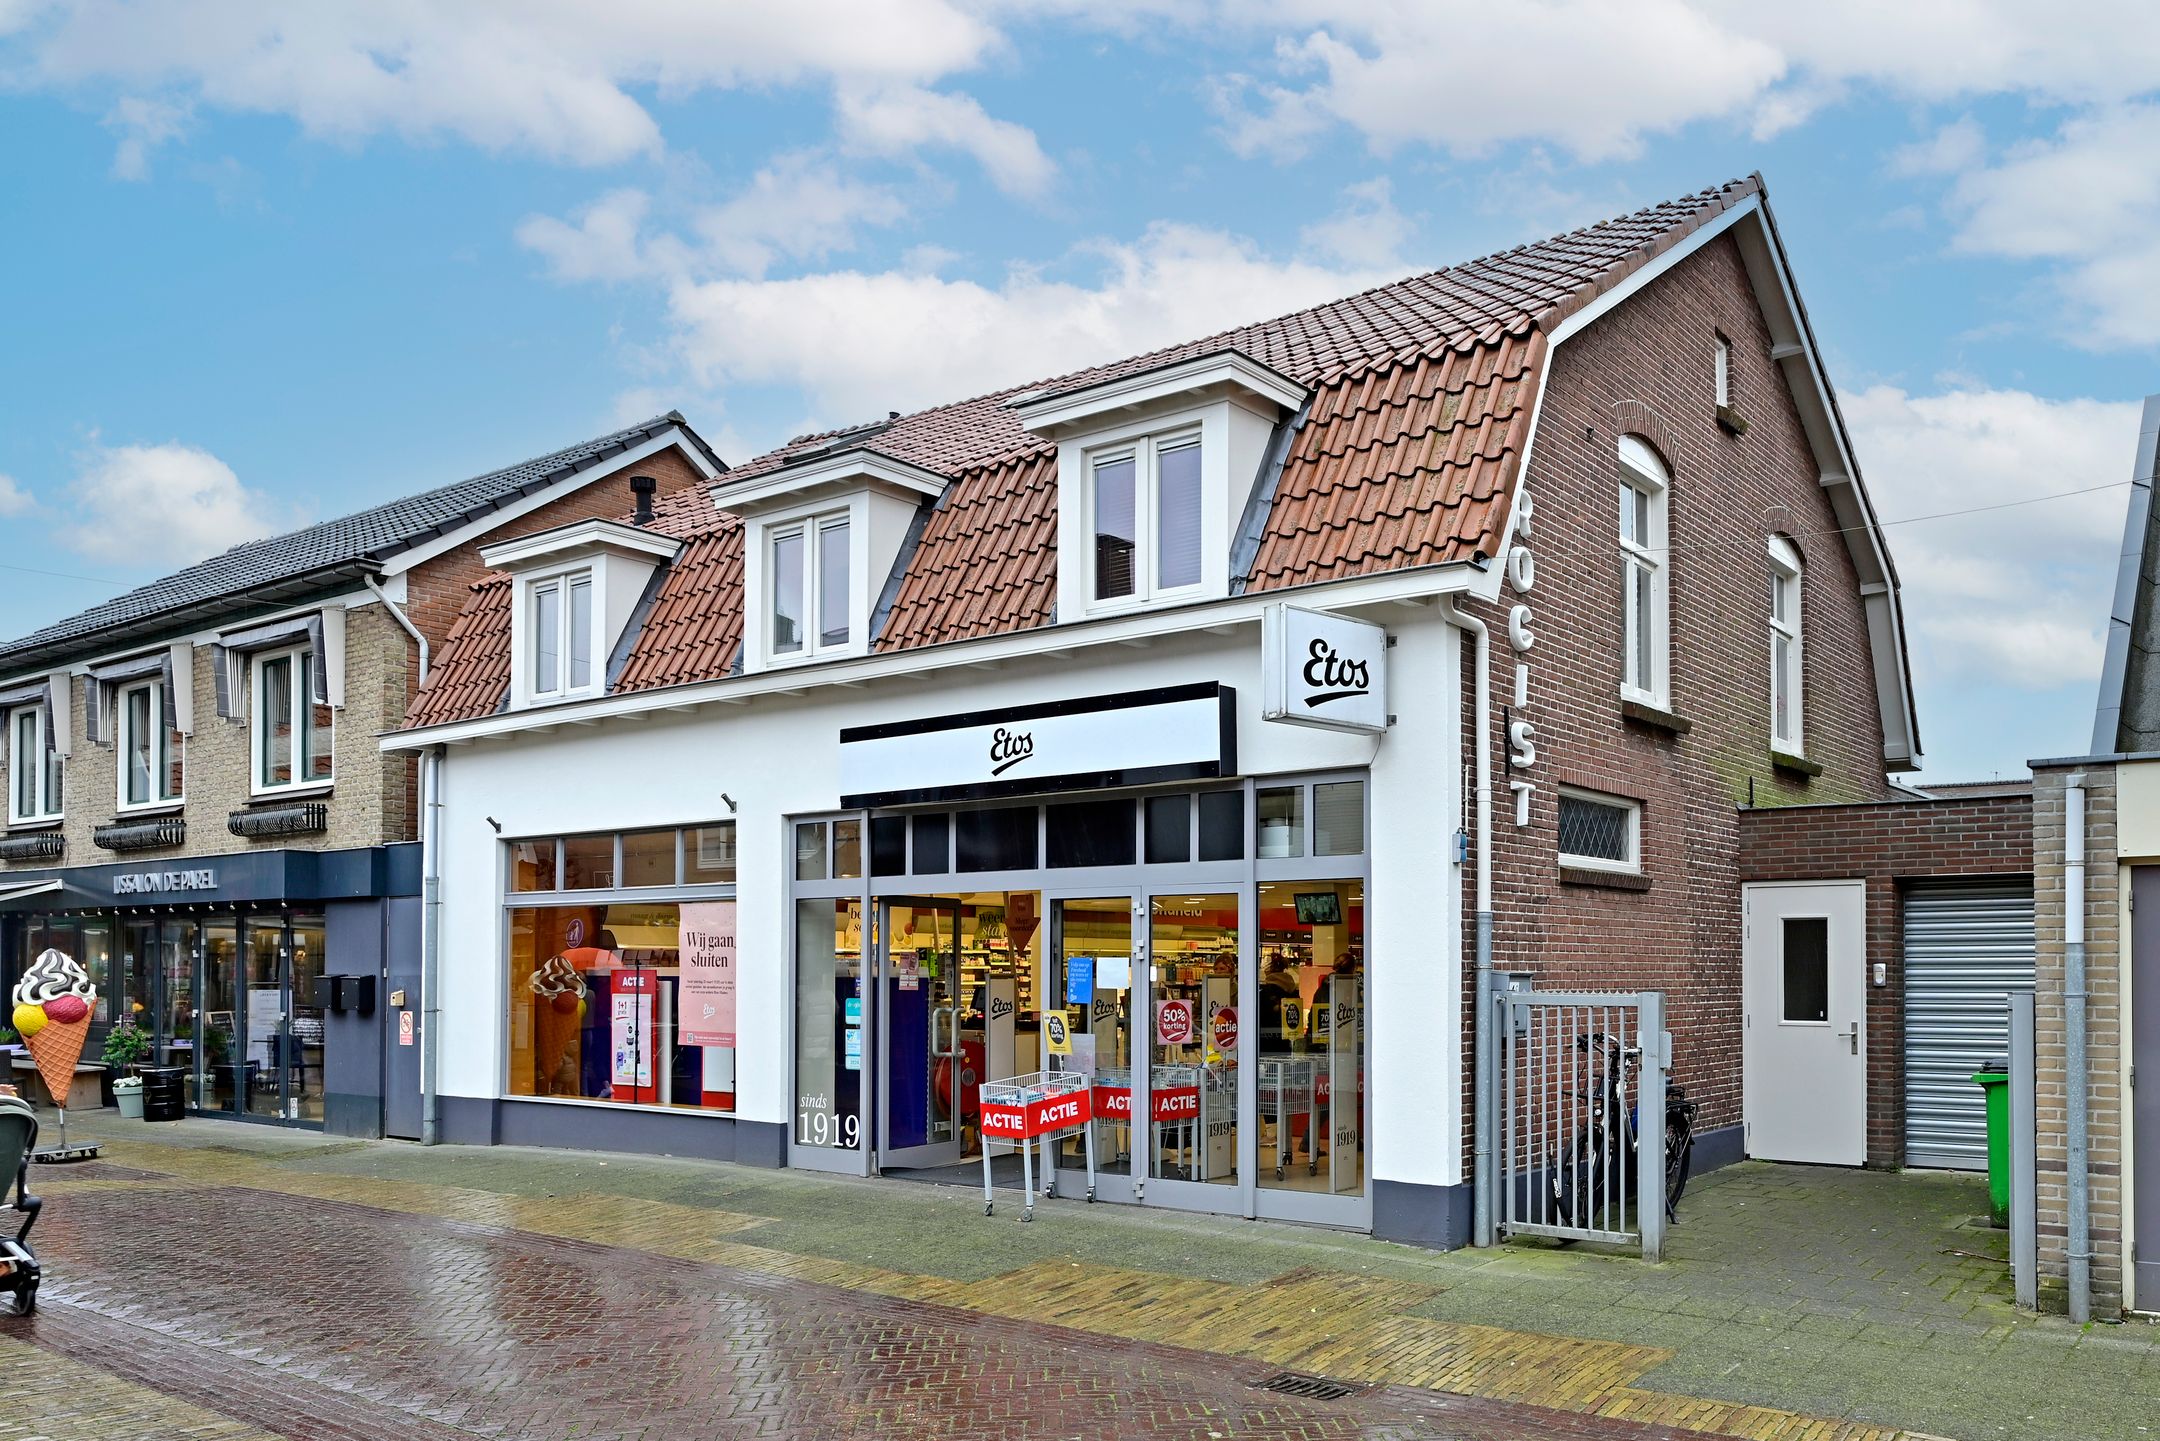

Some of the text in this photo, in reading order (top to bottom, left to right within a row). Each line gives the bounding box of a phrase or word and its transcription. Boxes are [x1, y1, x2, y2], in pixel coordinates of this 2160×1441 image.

[1303, 638, 1369, 690] Etos
[990, 727, 1034, 762] Etos
[163, 871, 181, 891] DE
[181, 869, 218, 890] PAREL
[686, 931, 734, 951] Wij gaan
[691, 951, 728, 968] sluiten
[622, 976, 645, 987] ACTE
[991, 997, 1013, 1014] Etos
[1094, 998, 1115, 1015] Etos
[1336, 1002, 1356, 1021] Etos
[1163, 1008, 1186, 1022] 50%
[1050, 1023, 1063, 1034] 70%
[1163, 1022, 1186, 1030] korting
[1215, 1020, 1237, 1033] actie
[800, 1092, 828, 1109] sinds
[1160, 1095, 1196, 1112] ACTIE
[983, 1112, 1024, 1130] ACTIE
[1040, 1101, 1079, 1124] ACTIE
[800, 1111, 860, 1148] 1919
[1208, 1121, 1230, 1137] 1919
[1336, 1130, 1356, 1147] 1919
